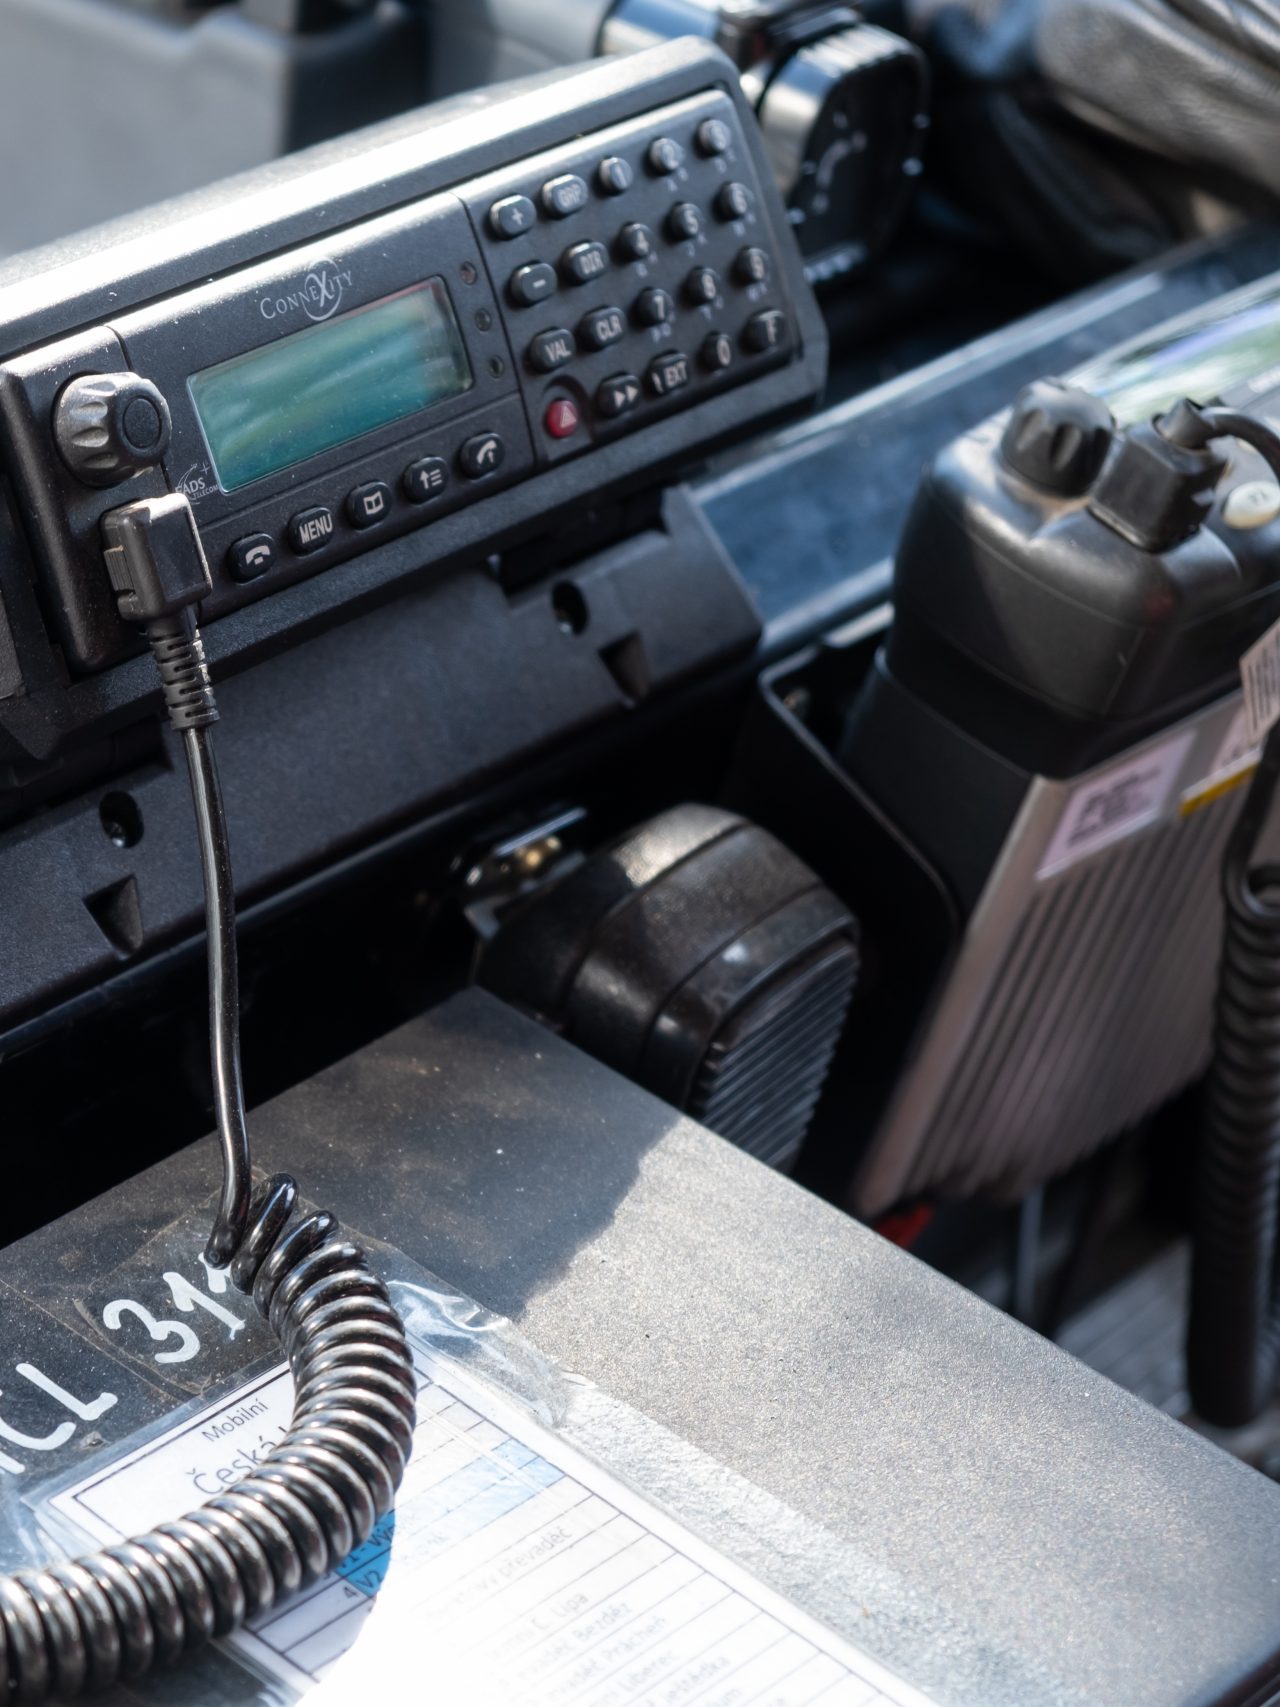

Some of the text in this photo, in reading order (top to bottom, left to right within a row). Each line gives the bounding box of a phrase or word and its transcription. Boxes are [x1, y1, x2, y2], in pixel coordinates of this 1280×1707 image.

[684, 209, 699, 235] 5
[595, 314, 623, 342] CLR
[544, 339, 570, 363] VAL
[298, 512, 334, 545] MENU
[201, 1397, 269, 1443] Mobilní
